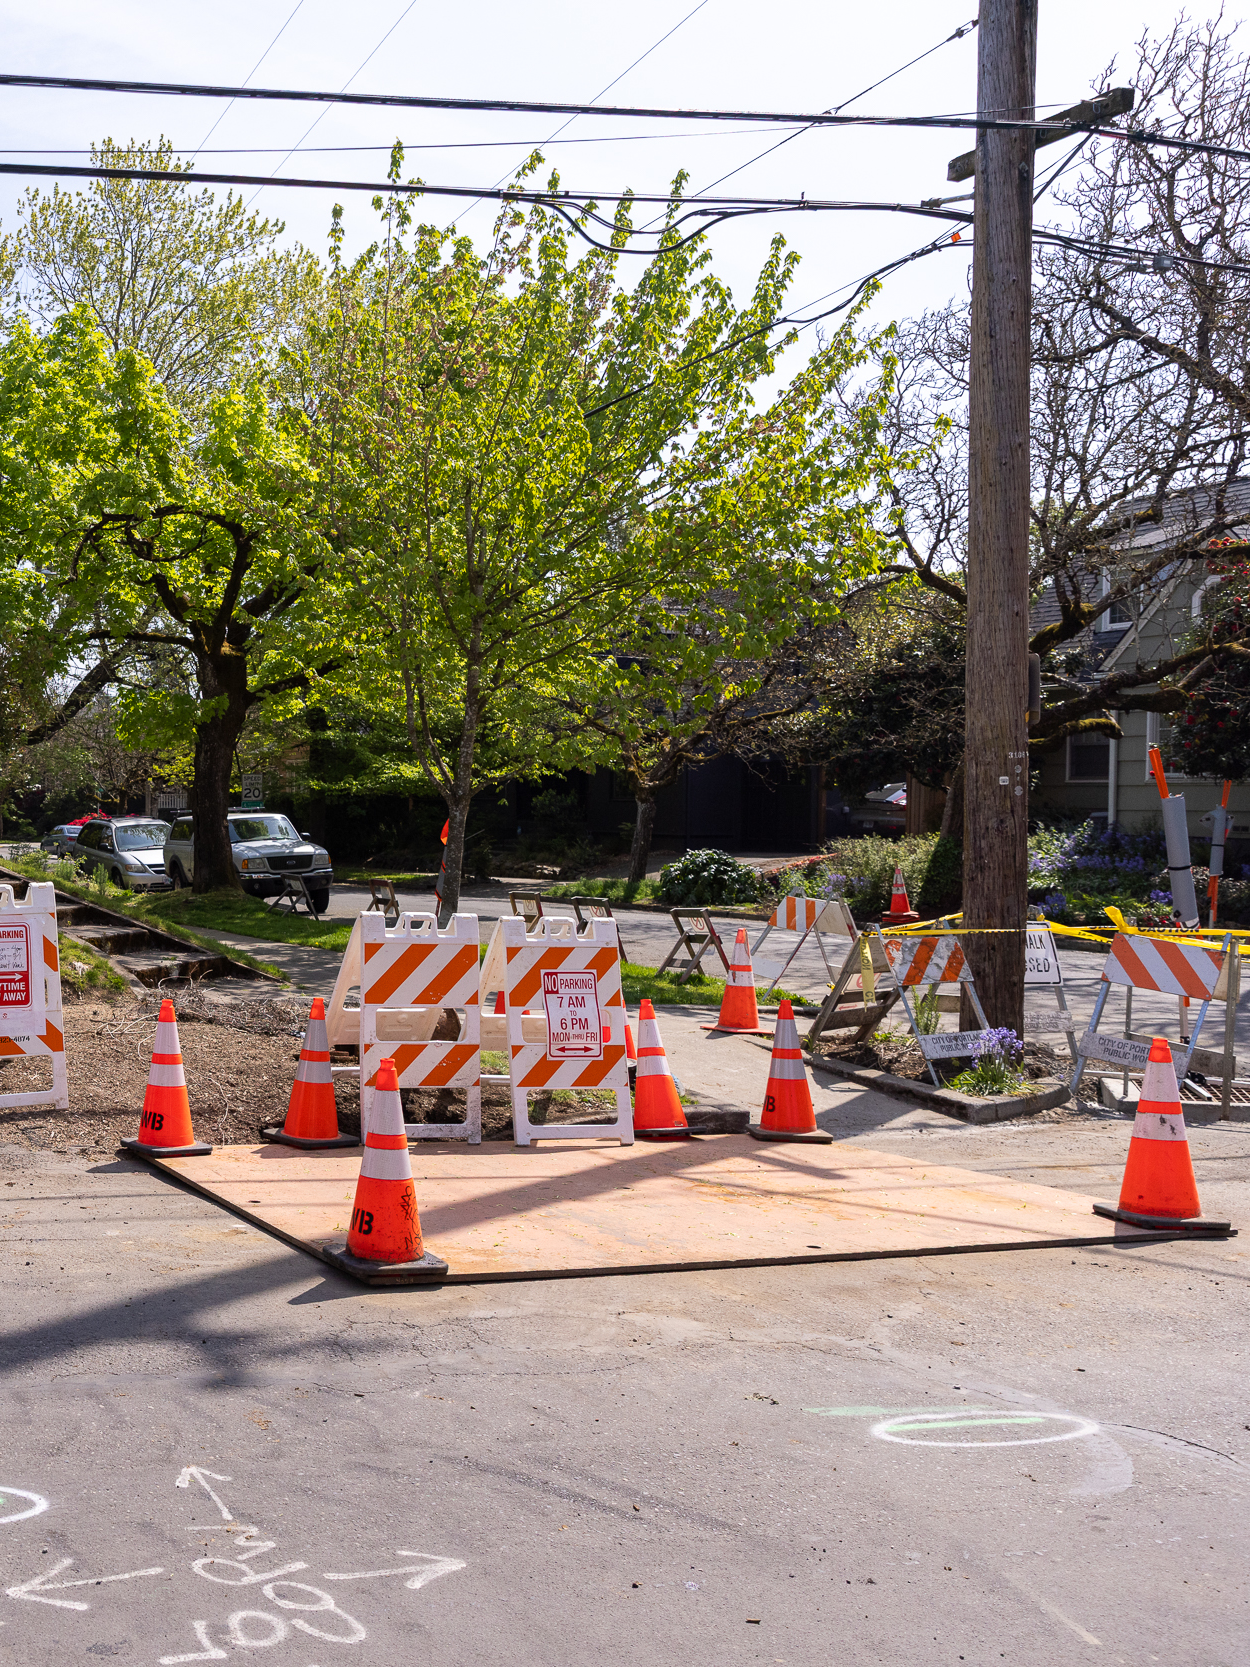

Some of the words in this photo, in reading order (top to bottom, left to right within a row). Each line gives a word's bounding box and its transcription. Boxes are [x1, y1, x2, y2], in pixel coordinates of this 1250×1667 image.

[244, 788, 261, 798] 20
[544, 974, 558, 992] NO
[559, 978, 593, 990] PARKING
[3, 992, 26, 1001] AWAY
[557, 996, 564, 1008] 7
[568, 996, 586, 1008] AM
[560, 1018, 568, 1031] 6
[571, 1018, 589, 1030] PM
[552, 1032, 570, 1042] MON
[585, 1032, 598, 1042] FRI
[931, 1036, 945, 1044] CITY
[939, 1043, 961, 1052] PUBLIC
[1098, 1037, 1117, 1046] CITY
[1117, 1041, 1129, 1050] OF
[1129, 1044, 1151, 1055] PORT
[1103, 1047, 1130, 1060] PUBLIC
